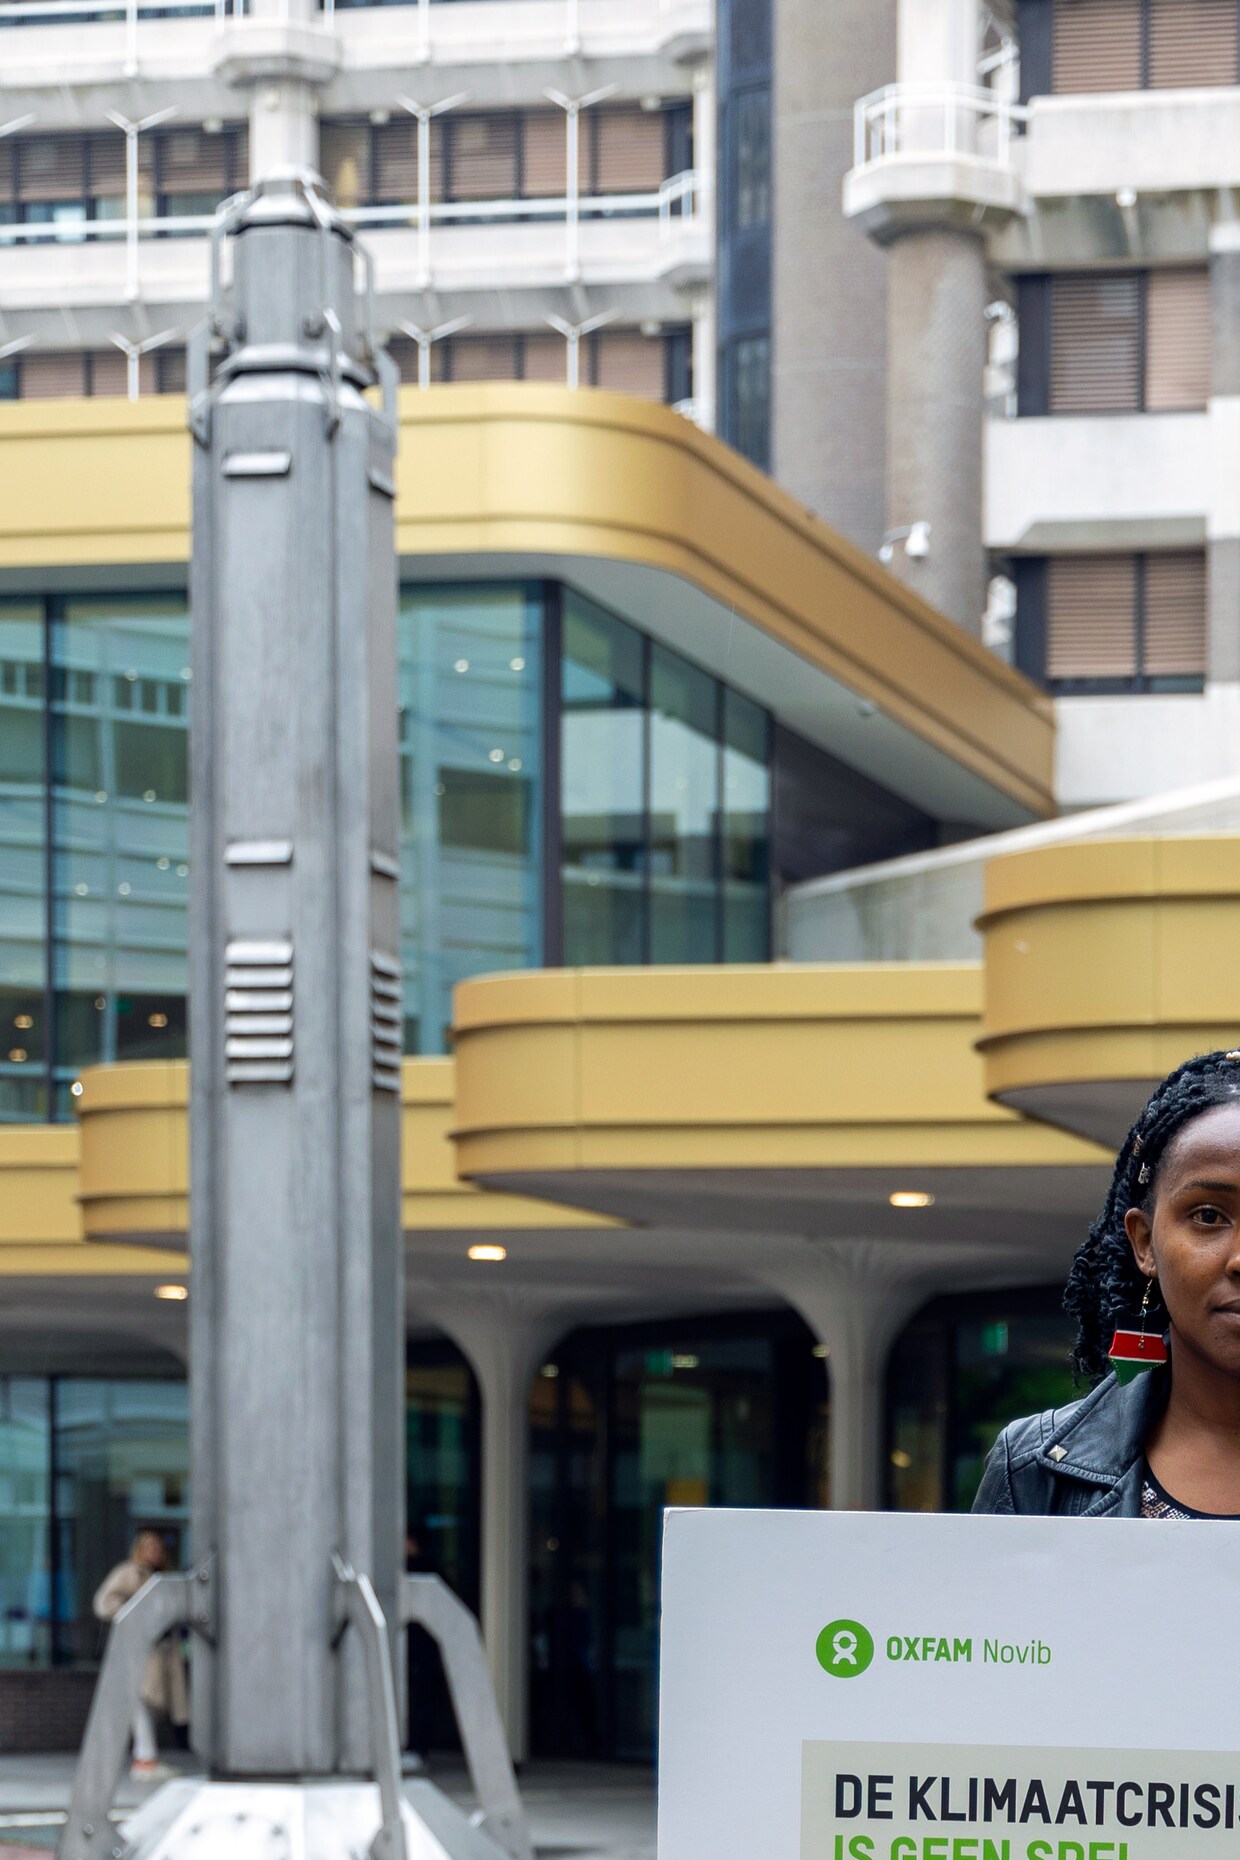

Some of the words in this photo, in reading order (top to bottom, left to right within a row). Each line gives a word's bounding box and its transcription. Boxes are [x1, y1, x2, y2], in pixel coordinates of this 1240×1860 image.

[886, 1635, 972, 1662] OXFAM
[983, 1638, 1051, 1664] Novib
[834, 1773, 894, 1820] DE
